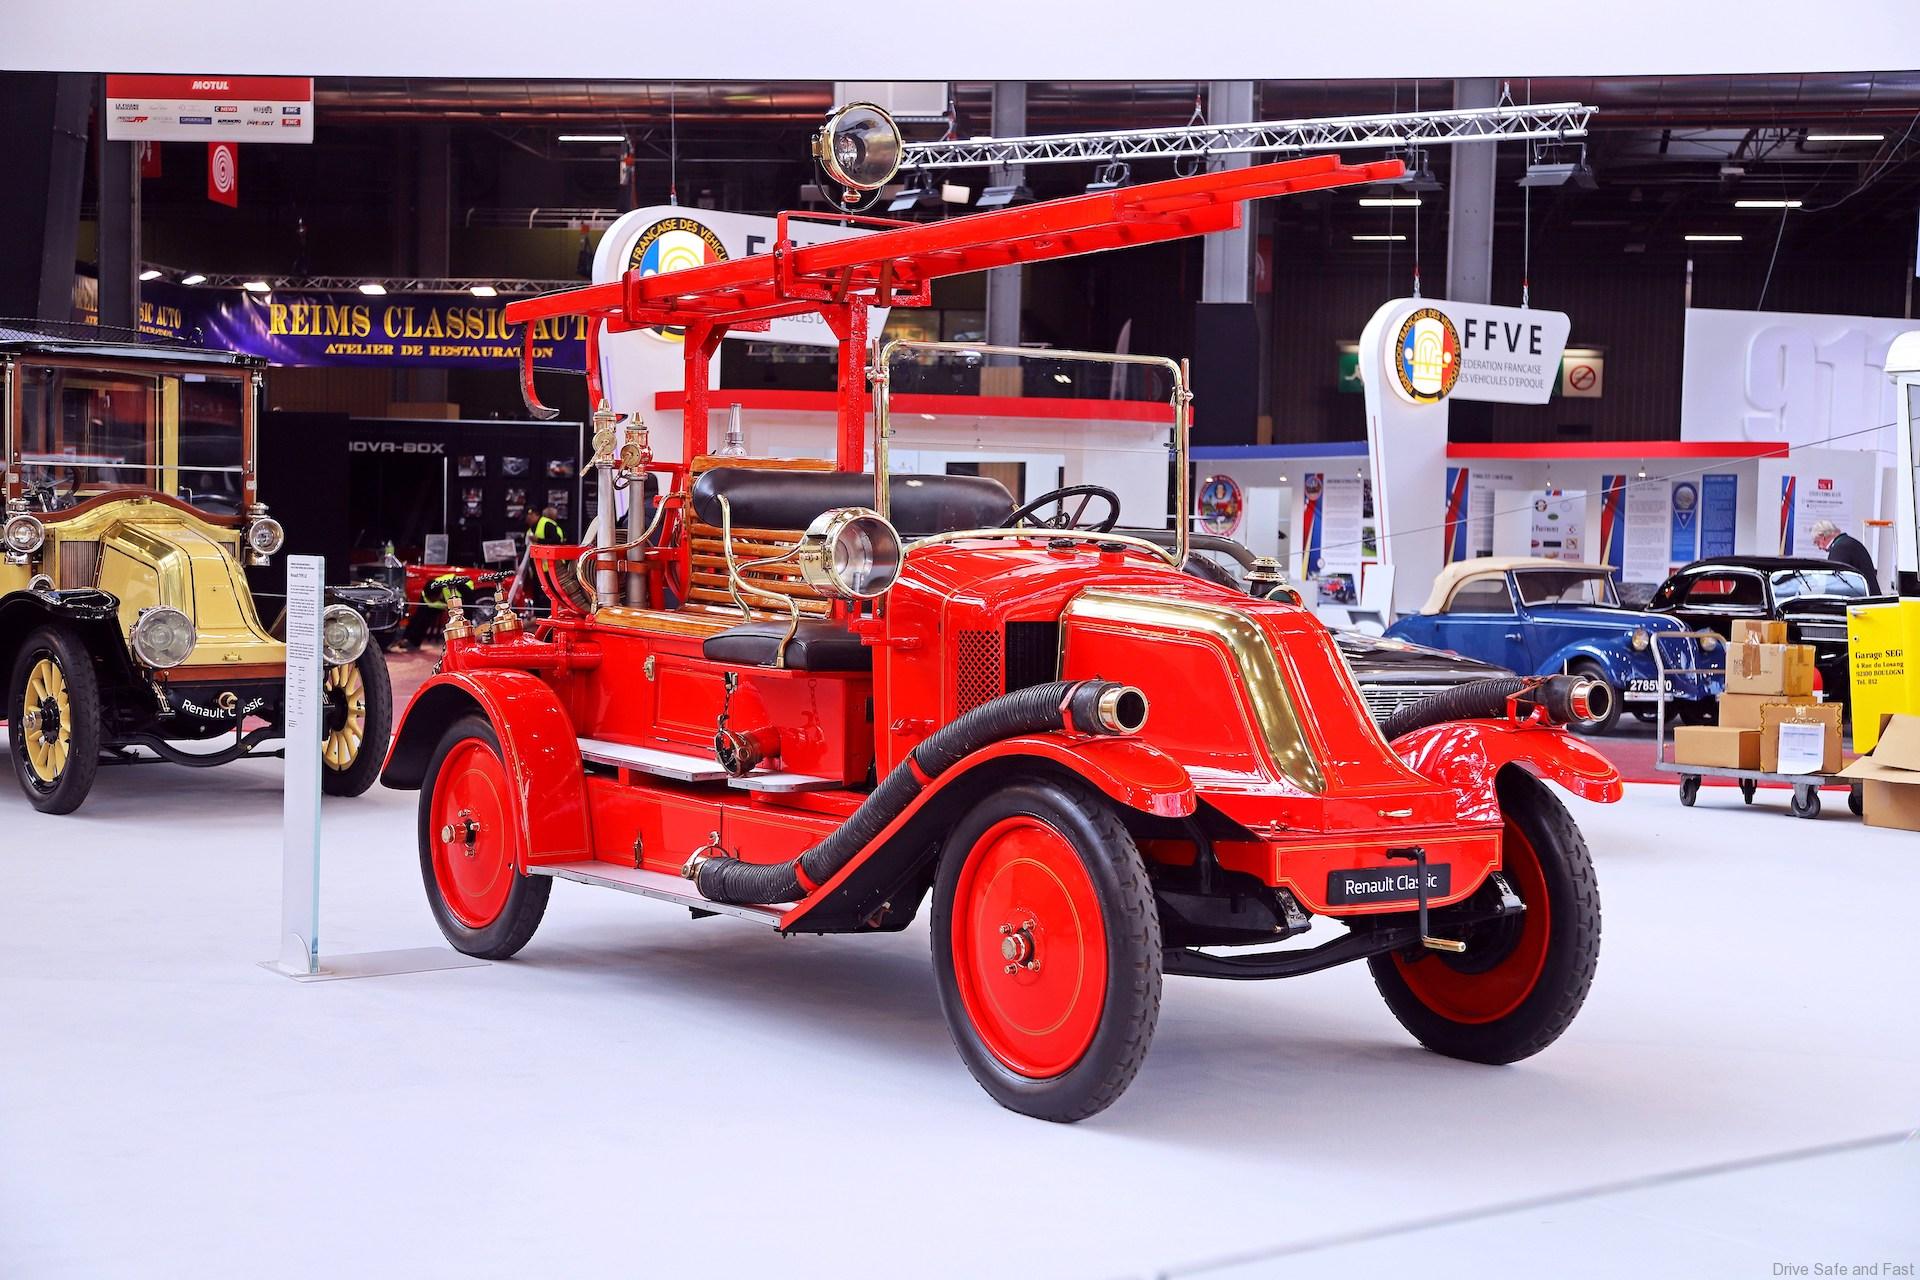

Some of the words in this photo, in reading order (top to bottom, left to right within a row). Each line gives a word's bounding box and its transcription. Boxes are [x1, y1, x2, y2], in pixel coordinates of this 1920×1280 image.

[192, 81, 229, 90] MOTUL
[680, 219, 698, 232] DES
[156, 306, 181, 329] AUTO
[269, 303, 371, 337] REIMS
[384, 305, 517, 340] CLASSIC
[1464, 319, 1542, 355] FFVE
[325, 344, 393, 355] ATELIER
[401, 345, 423, 356] DE
[429, 345, 554, 358] RESTAURATON
[1462, 359, 1503, 371] EDERATION
[1856, 651, 1882, 660] Garage
[182, 699, 225, 718] Renault
[1345, 876, 1394, 895] Renault
[1397, 873, 1437, 890] Clasic
